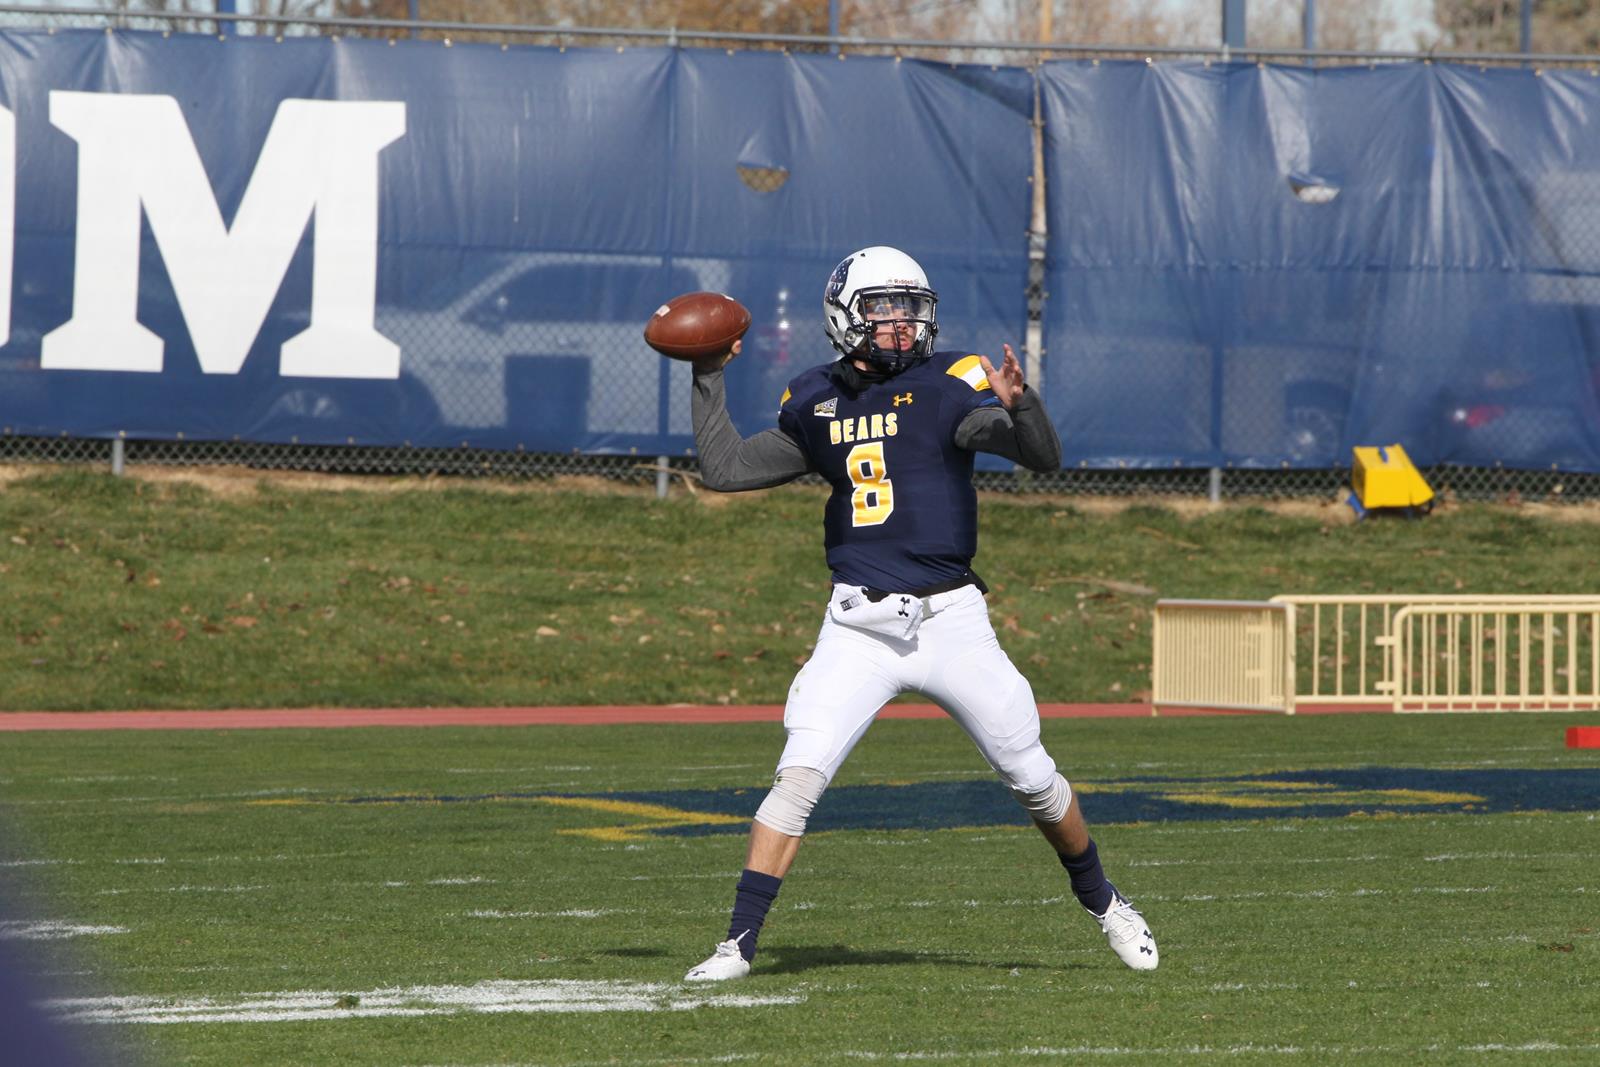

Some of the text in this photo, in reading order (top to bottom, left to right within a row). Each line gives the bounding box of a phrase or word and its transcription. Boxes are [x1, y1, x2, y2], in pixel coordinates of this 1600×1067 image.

[0, 90, 406, 379] M
[829, 412, 898, 445] BEARS
[846, 441, 894, 527] 8
